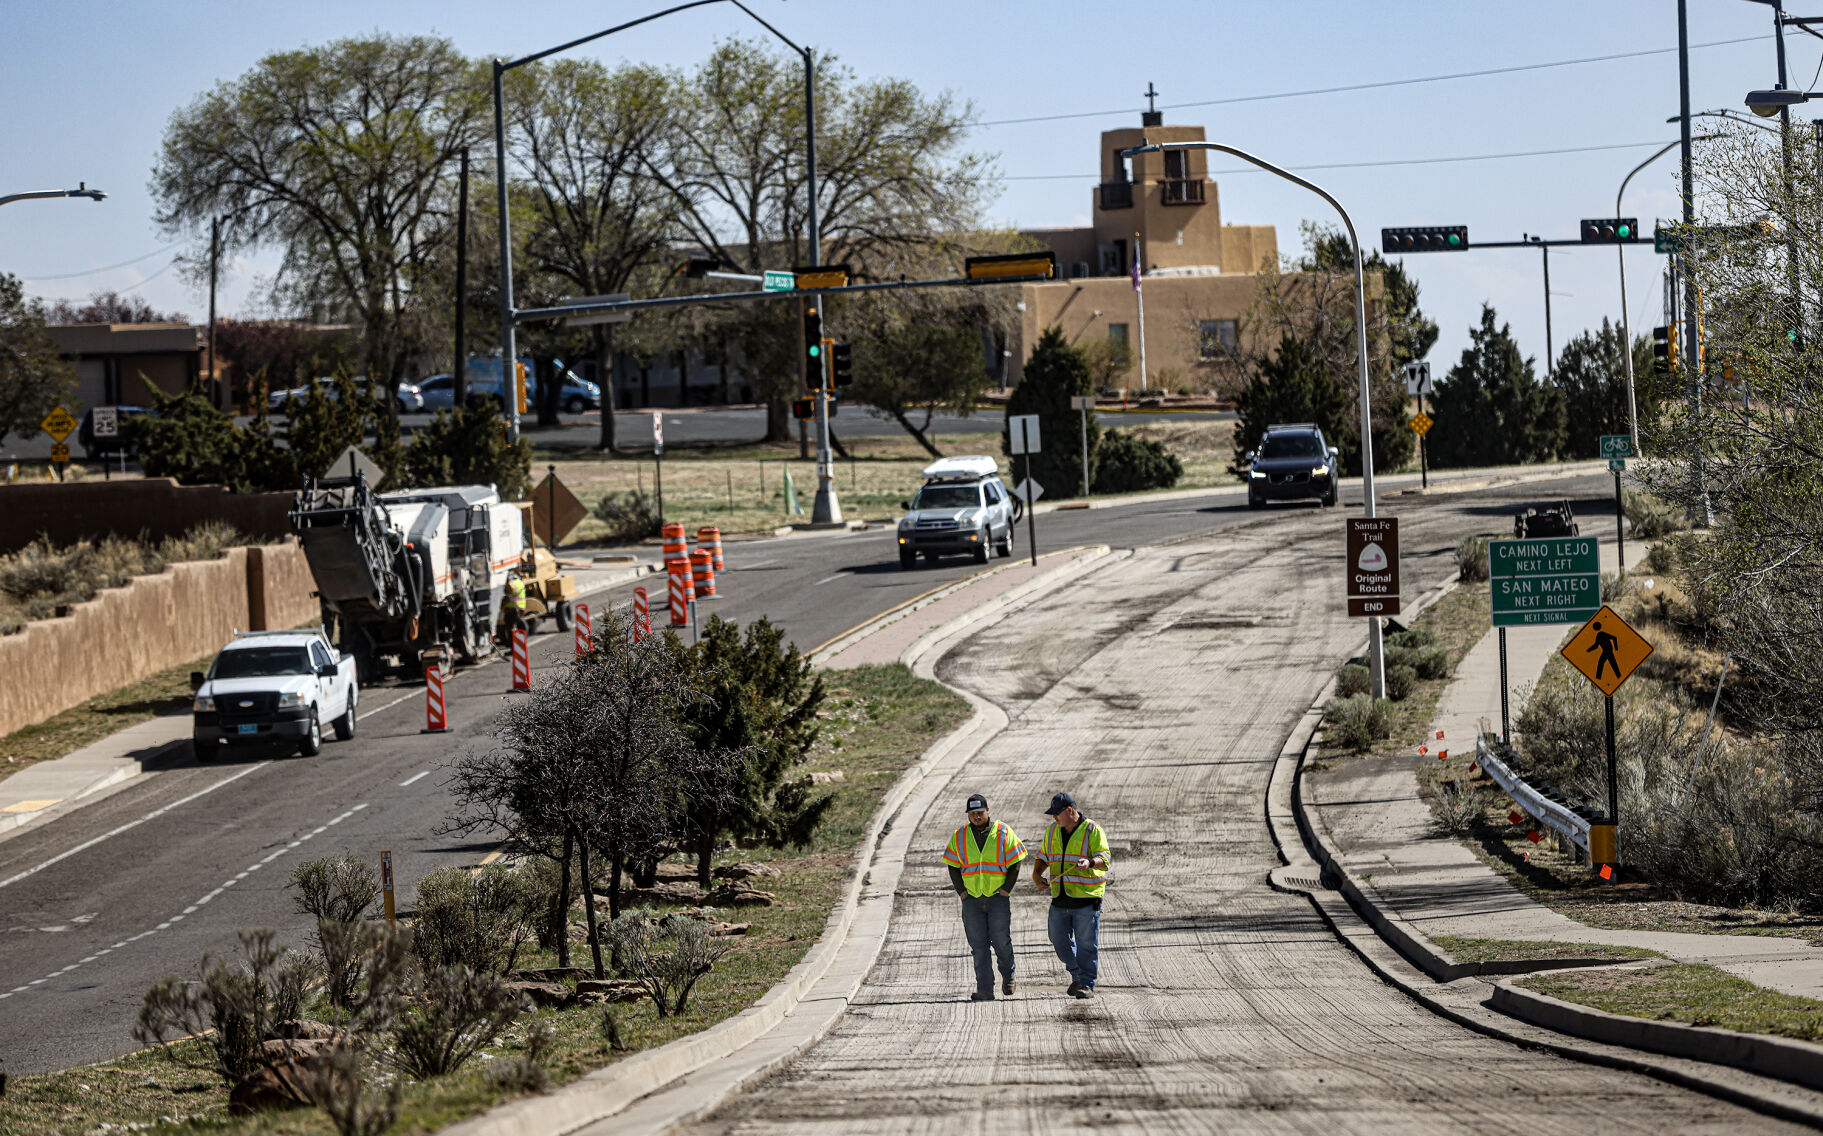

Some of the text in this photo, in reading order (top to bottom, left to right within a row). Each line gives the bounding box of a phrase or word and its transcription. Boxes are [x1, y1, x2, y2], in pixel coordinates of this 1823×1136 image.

[96, 421, 115, 433] 25
[1354, 521, 1390, 530] Santa Fe
[1362, 532, 1383, 541] Trail
[1499, 542, 1589, 558] CAMINO LEJO
[1516, 559, 1572, 571] NEXT LEFT
[1355, 573, 1392, 585] Original
[1359, 584, 1387, 593] Route
[1502, 578, 1589, 594] SAN MATEO
[1515, 594, 1577, 607] NEXT RIGHT
[1364, 602, 1384, 612] END
[1524, 612, 1569, 622] NEXT SIGNAL
